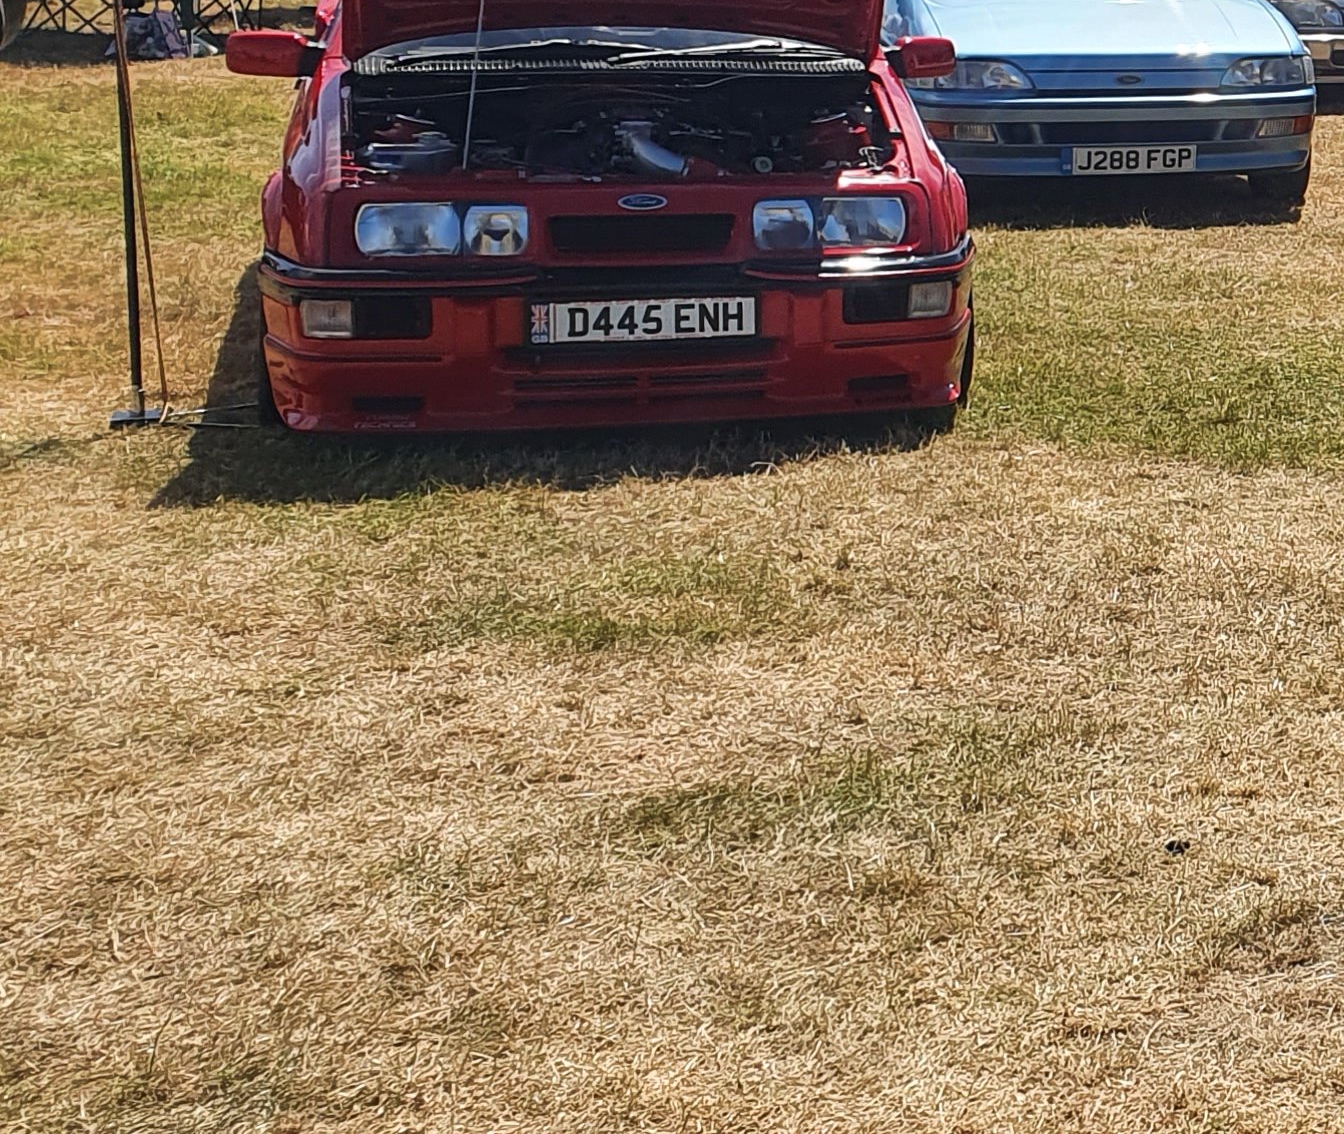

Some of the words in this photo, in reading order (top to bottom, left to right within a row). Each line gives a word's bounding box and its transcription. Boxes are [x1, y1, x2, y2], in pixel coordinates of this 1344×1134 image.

[1078, 150, 1140, 170] J288
[1147, 148, 1192, 169] FGP
[567, 305, 663, 337] D445
[674, 302, 744, 334] ENH
